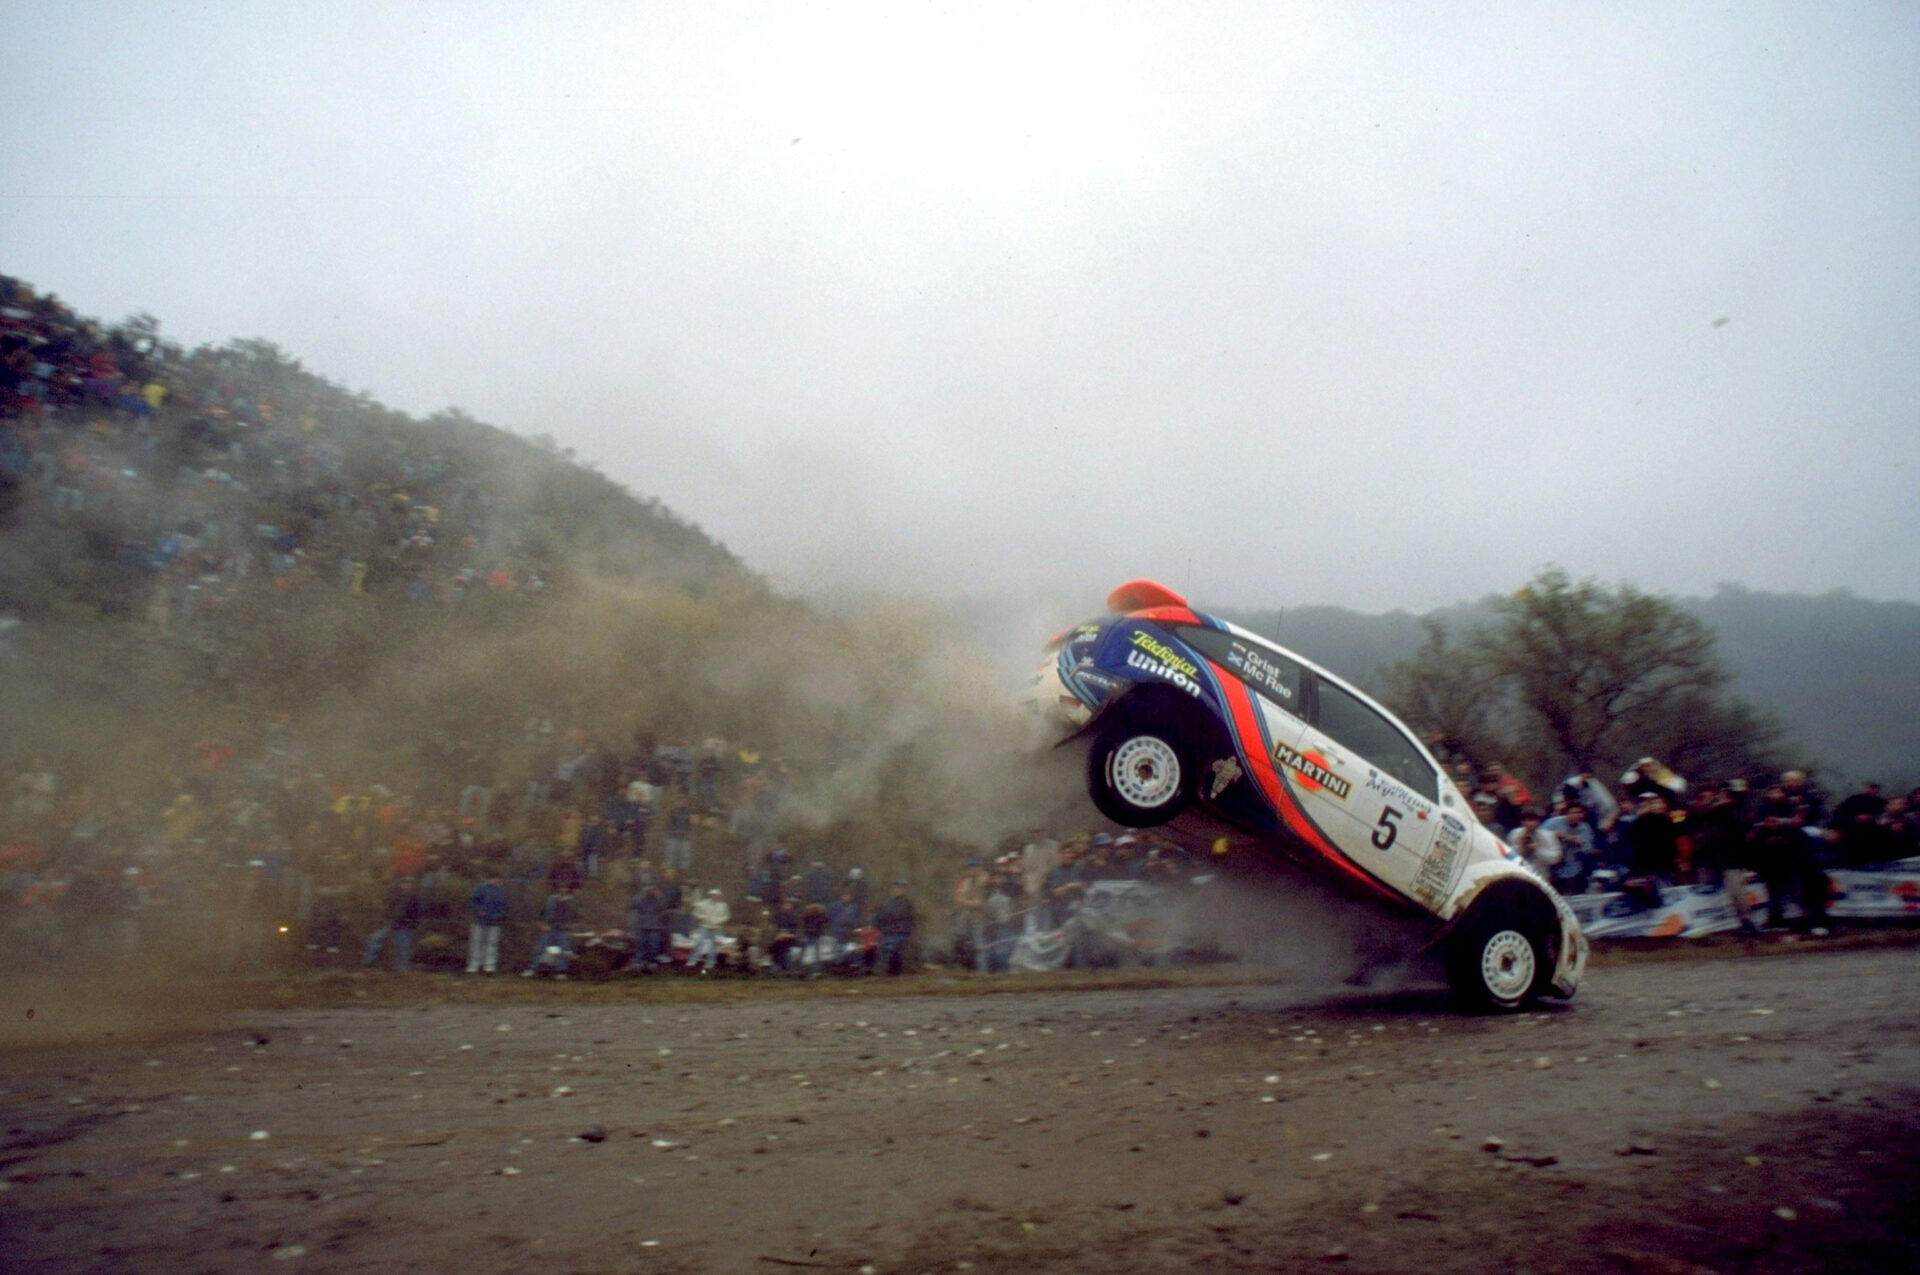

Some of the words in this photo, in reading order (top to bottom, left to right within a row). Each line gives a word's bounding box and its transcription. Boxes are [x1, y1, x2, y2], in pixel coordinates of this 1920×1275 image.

[1243, 660, 1265, 681] Mc
[1265, 674, 1292, 699] Rae
[1247, 650, 1280, 678] Grist
[1277, 745, 1349, 796] MARTINI
[1371, 804, 1404, 851] 5
